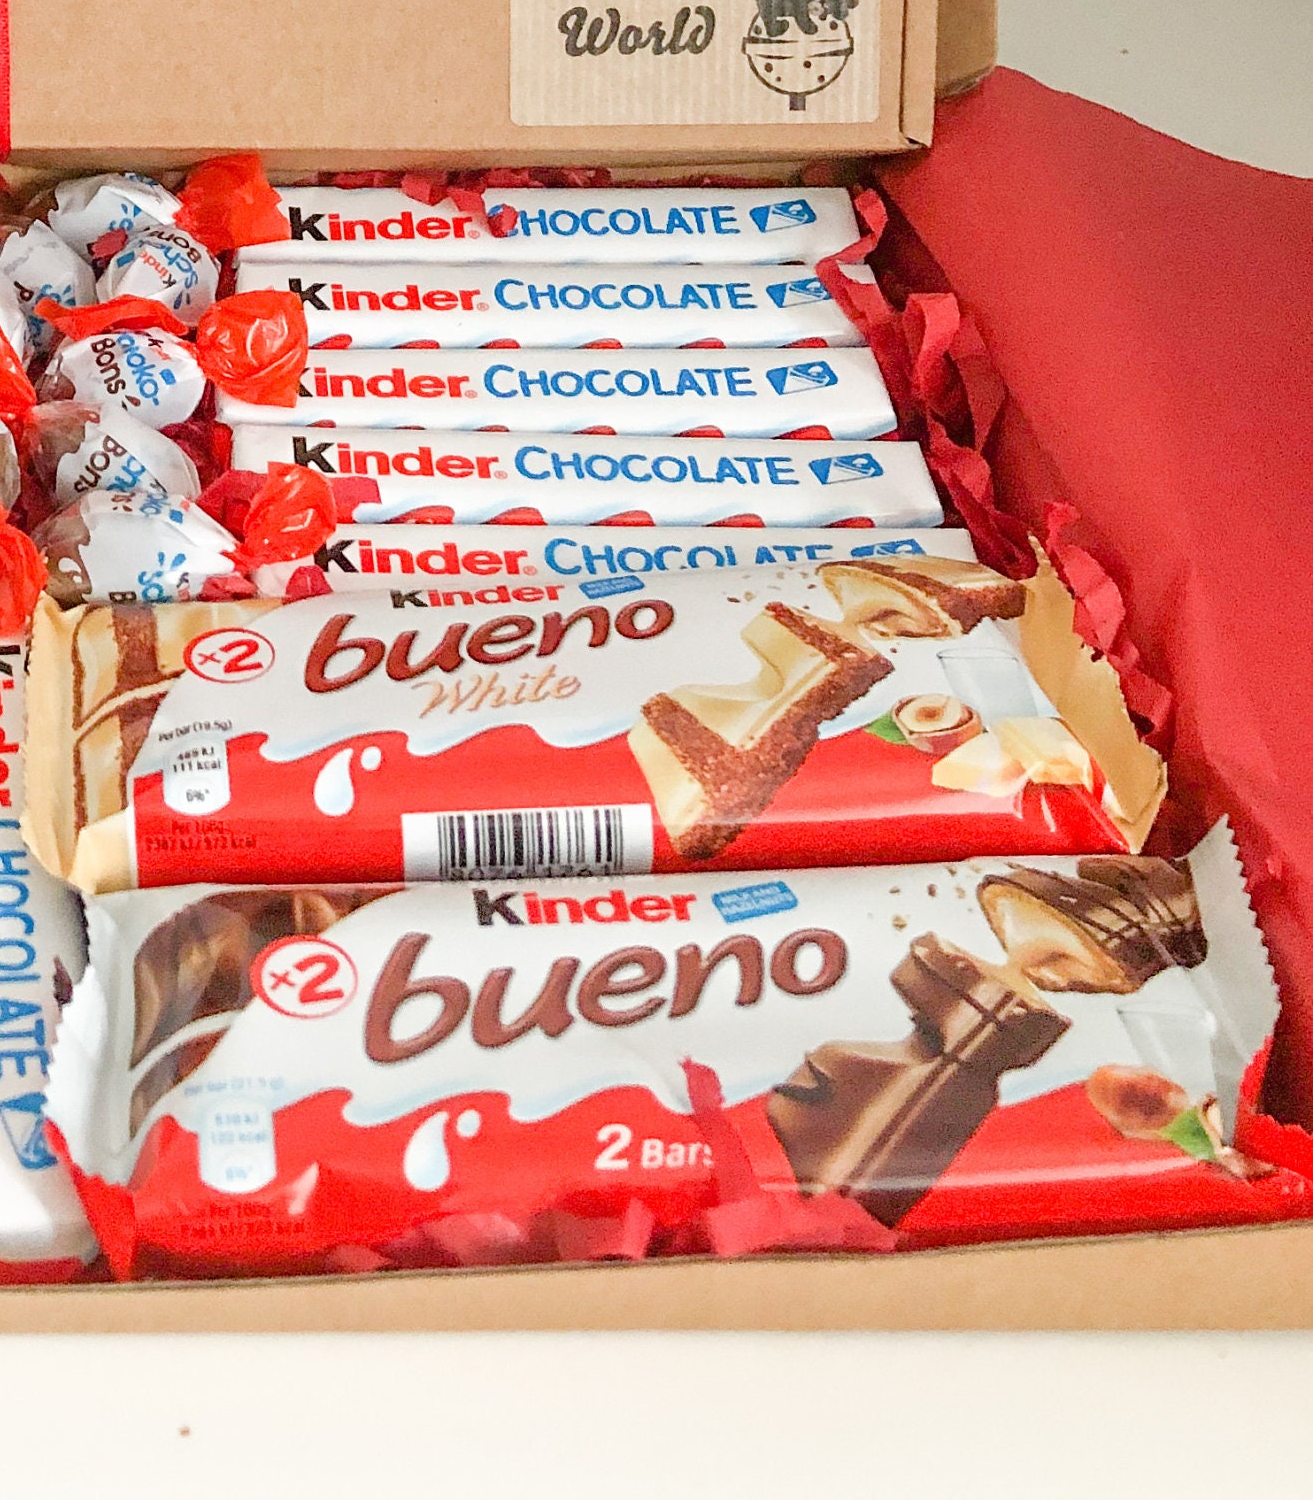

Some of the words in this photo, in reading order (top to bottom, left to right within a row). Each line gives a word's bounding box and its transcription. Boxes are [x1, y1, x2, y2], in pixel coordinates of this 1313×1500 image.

[558, 6, 716, 57] World
[493, 277, 758, 311] CHOCOLATE
[483, 364, 758, 398] CHOCOLATE
[514, 444, 799, 485] CHOCOLATE
[304, 599, 675, 695] bueno
[412, 664, 583, 718] White
[363, 927, 850, 1066] bueno
[594, 1123, 633, 1170] 2
